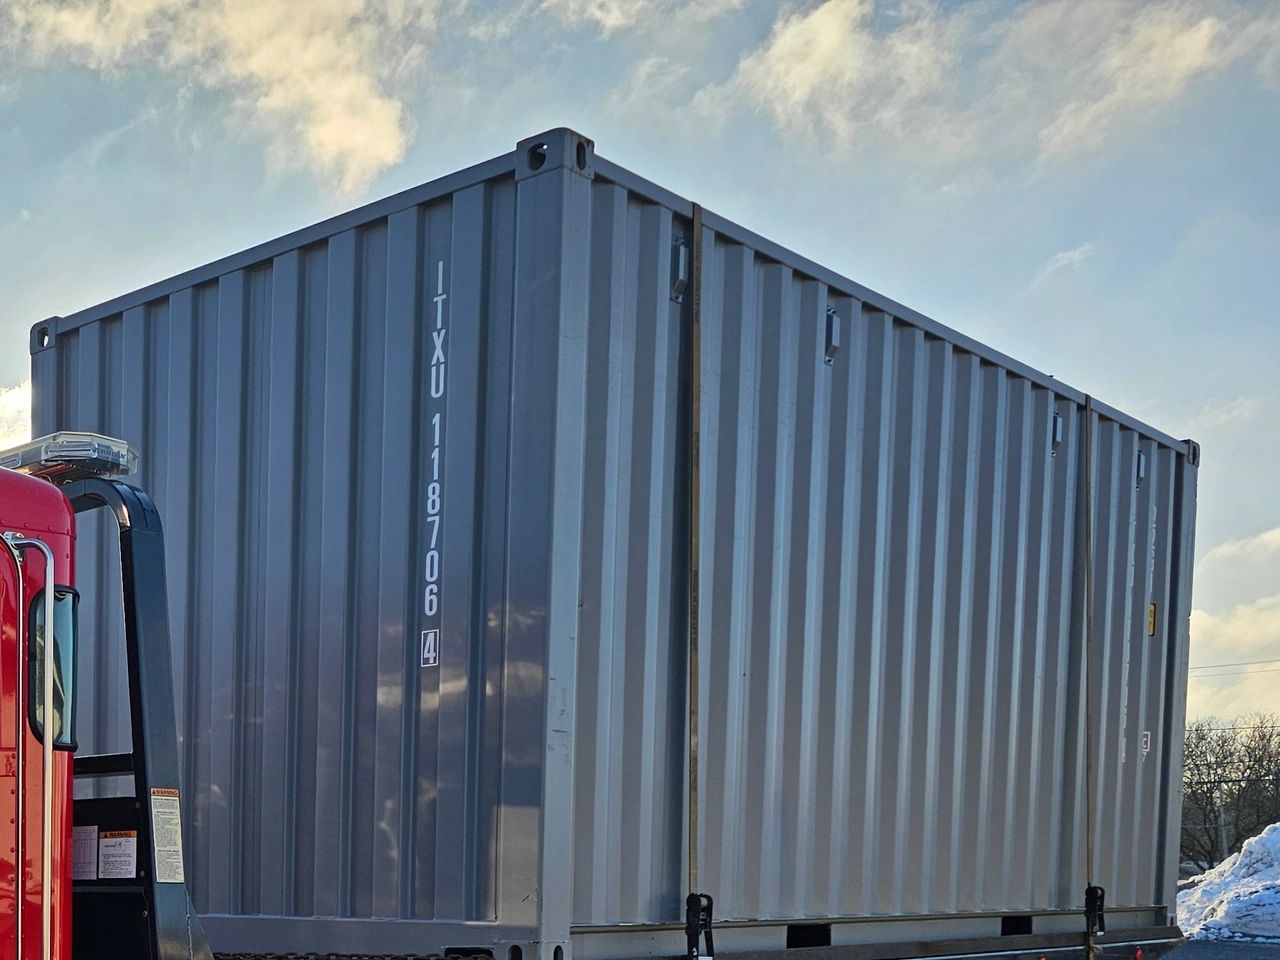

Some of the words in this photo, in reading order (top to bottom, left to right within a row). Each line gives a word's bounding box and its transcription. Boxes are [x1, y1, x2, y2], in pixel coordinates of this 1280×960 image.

[431, 261, 446, 397] ITXU
[424, 413, 440, 616] 118706
[422, 632, 437, 665] 4
